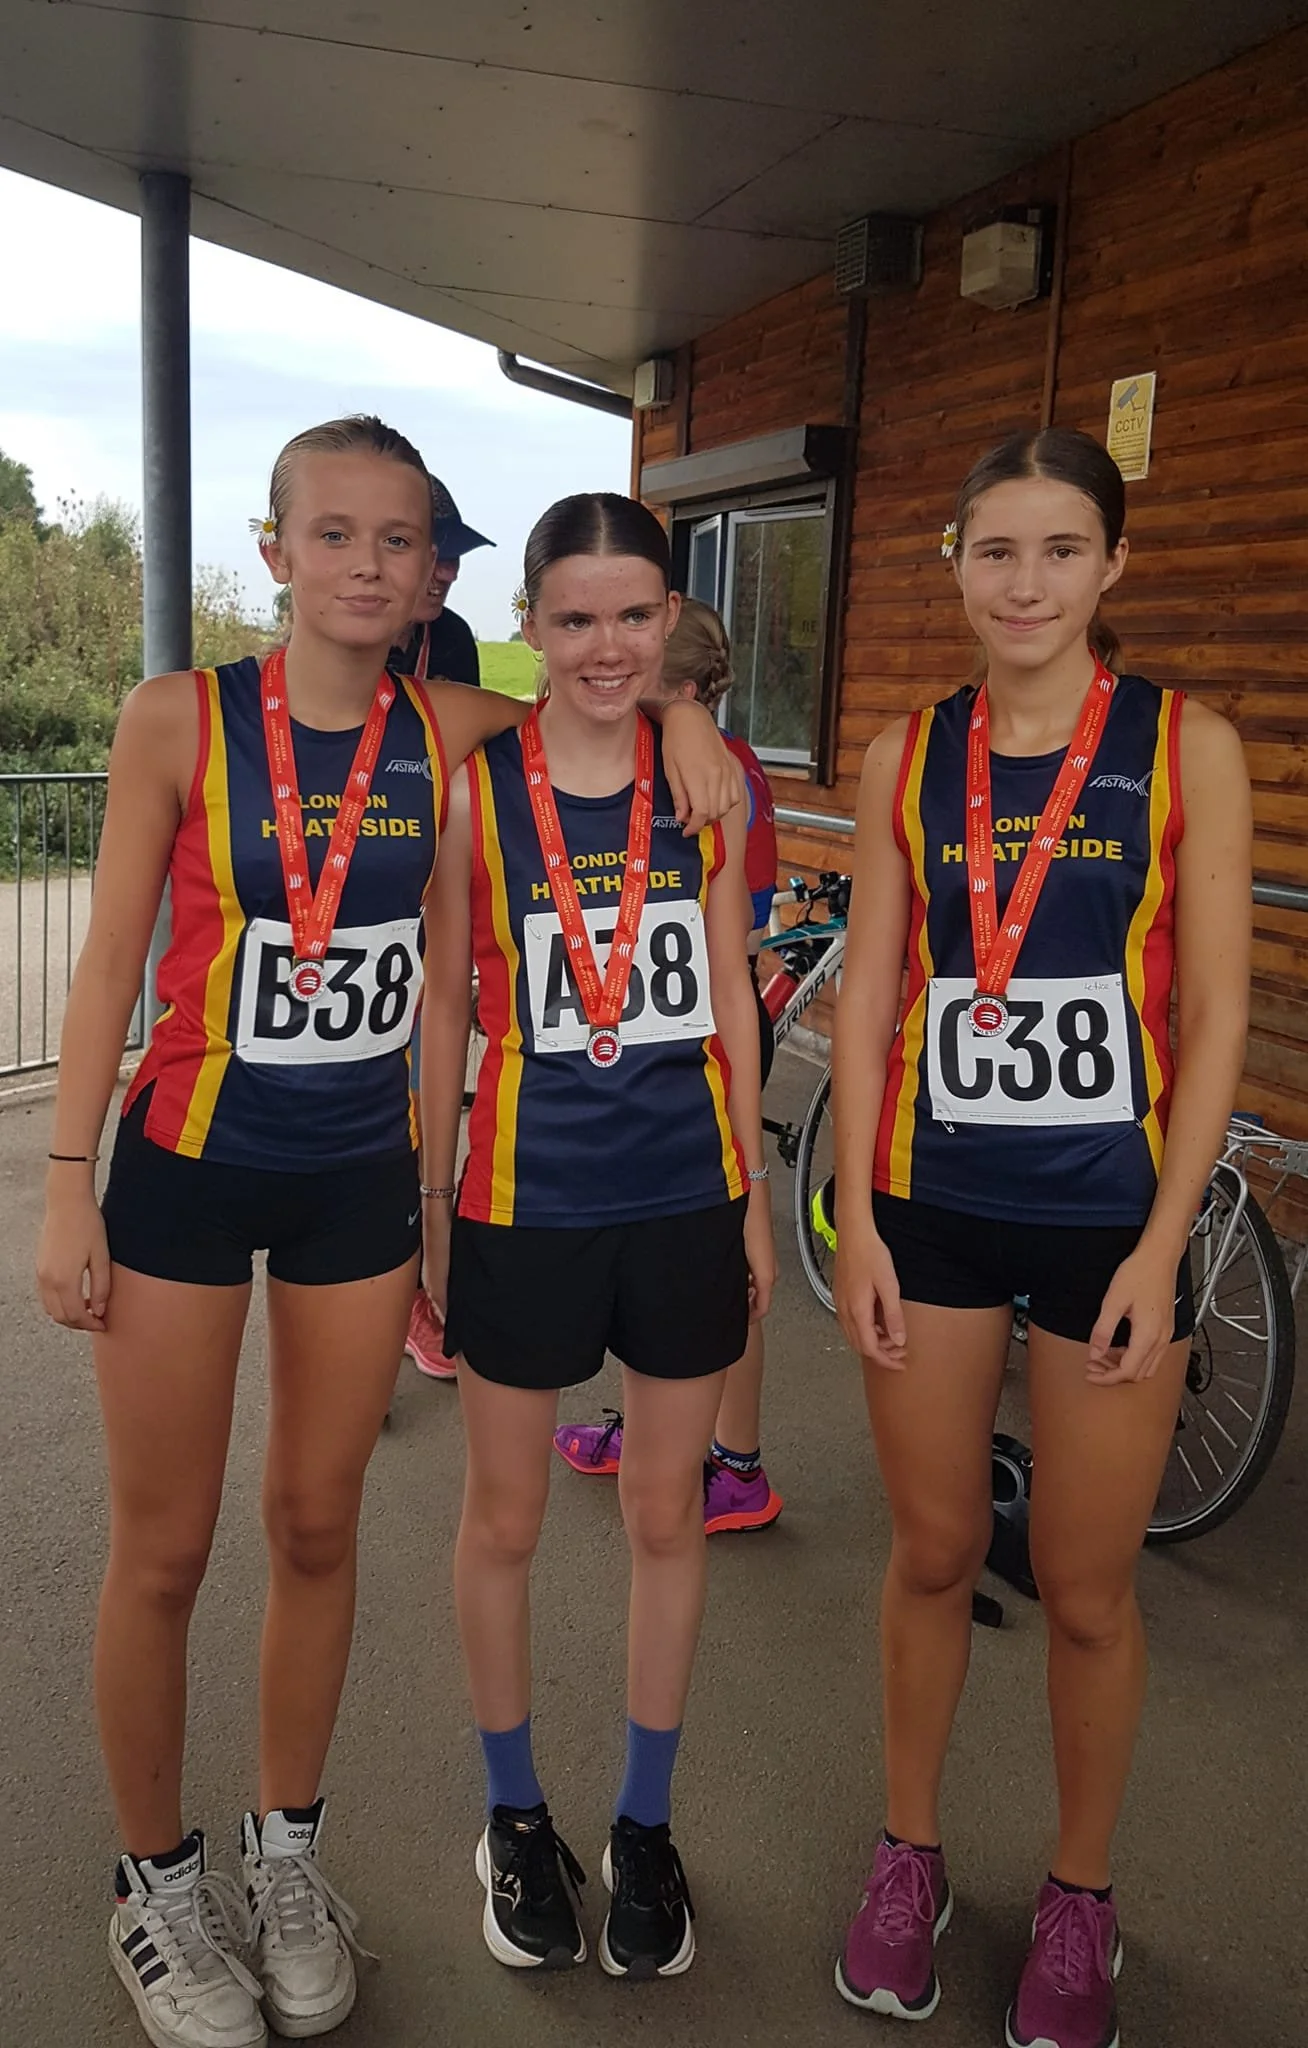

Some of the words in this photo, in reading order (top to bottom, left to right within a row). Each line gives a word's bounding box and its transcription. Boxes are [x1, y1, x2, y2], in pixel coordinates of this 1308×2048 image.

[1115, 416, 1144, 433] CCTV
[1083, 708, 1095, 737] MIDDLESEX
[1085, 728, 1096, 750] COUNTY
[1092, 700, 1104, 728] ATHLETICS
[299, 794, 388, 809] LONN
[261, 818, 422, 838] HATSIDE
[651, 815, 684, 829] FASTRA
[991, 814, 1085, 833] ONN
[569, 851, 628, 870] ONDO
[942, 838, 1123, 864] HATSIDE
[531, 870, 682, 900] HATHDE
[1017, 871, 1032, 904] MIDDLESEX
[1019, 892, 1031, 917] COUNTY
[1028, 860, 1043, 892] ATHLETICS
[253, 941, 413, 1041] B38
[775, 969, 826, 1047] ERIDA
[939, 998, 1115, 1101] C38
[722, 1457, 753, 1472] NIKE
[287, 1829, 310, 1840] adid
[164, 1861, 199, 1882] adida
